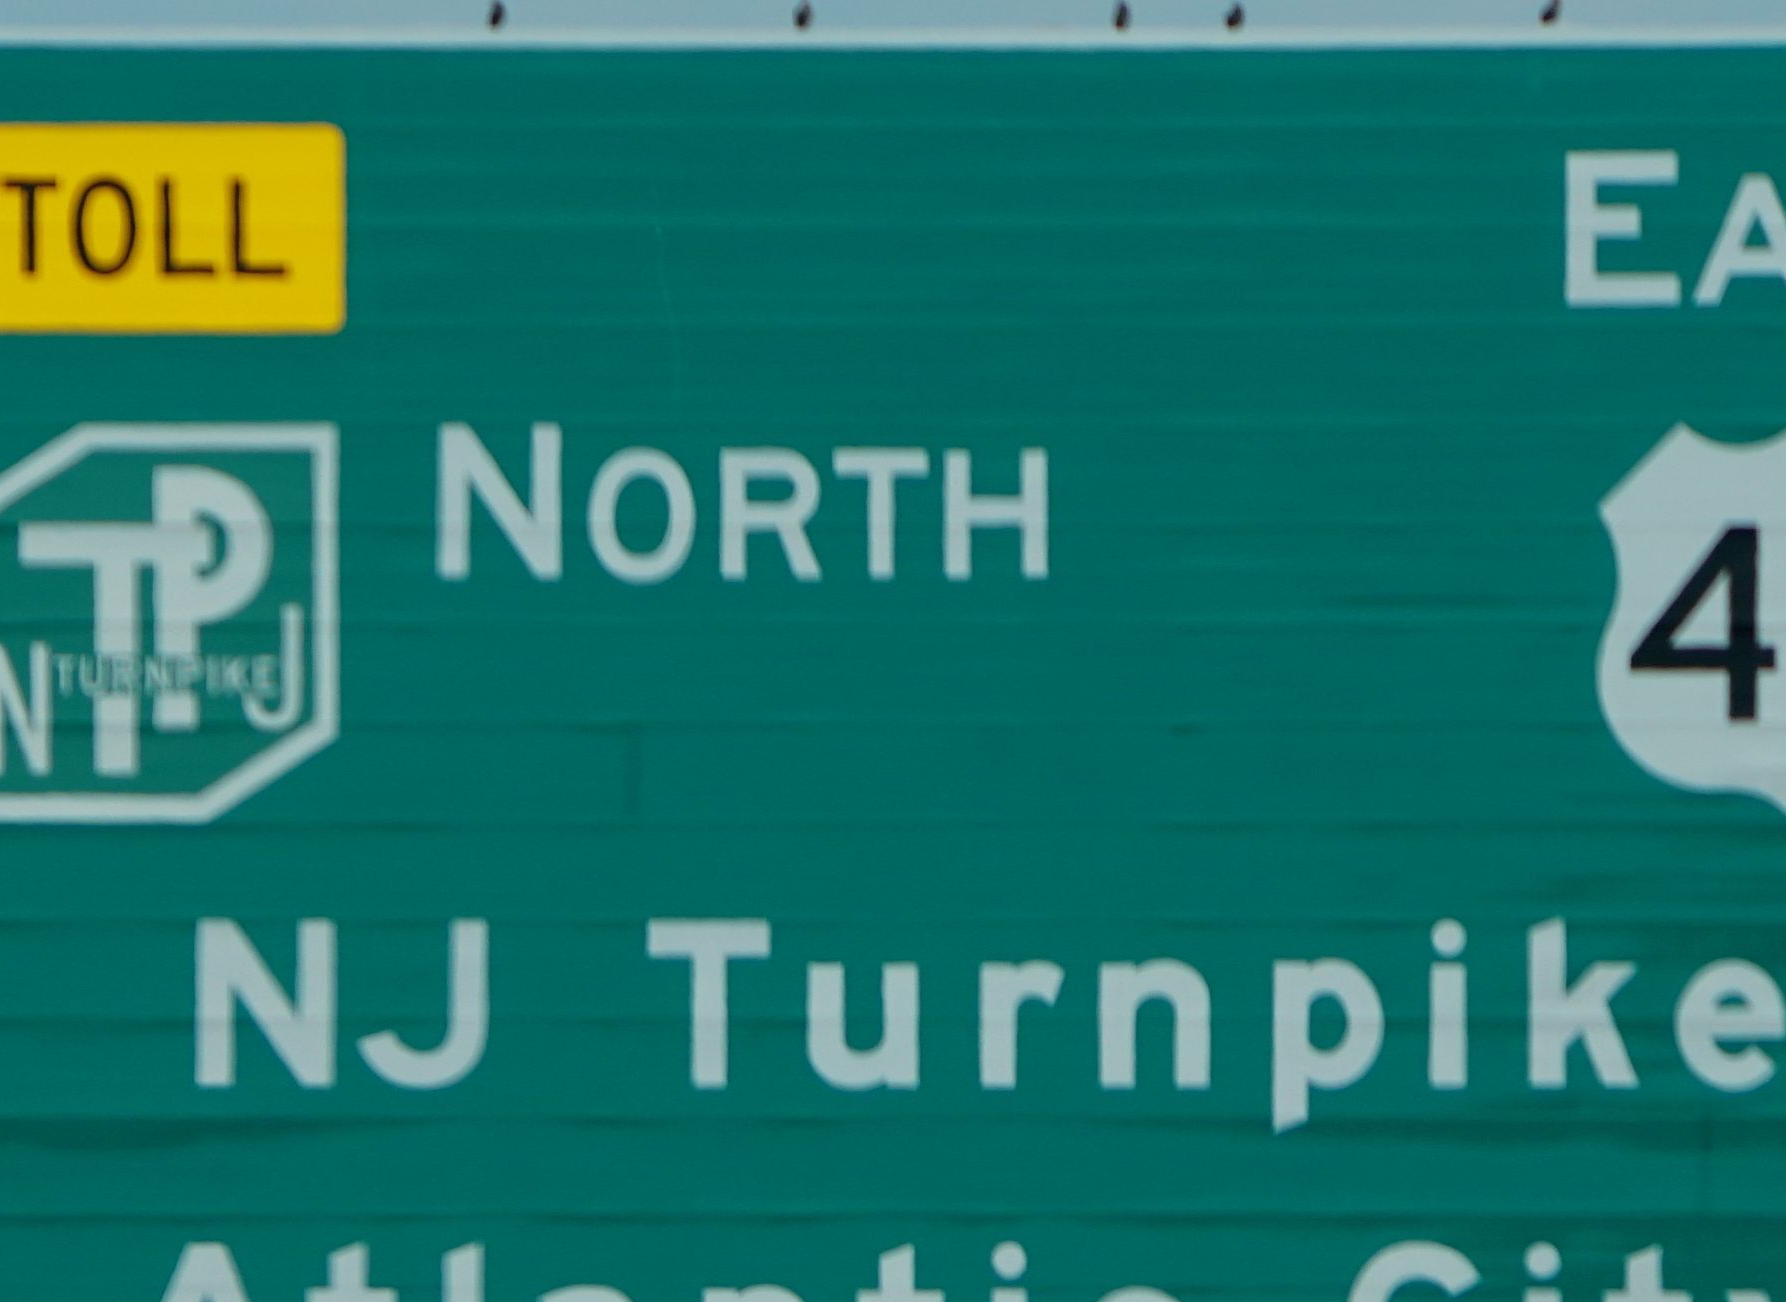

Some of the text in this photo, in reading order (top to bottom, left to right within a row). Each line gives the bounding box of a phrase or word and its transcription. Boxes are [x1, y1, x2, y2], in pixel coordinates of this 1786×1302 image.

[2, 175, 288, 279] TOLL
[435, 421, 1050, 584] NORTH
[53, 654, 280, 697] TURNPIKE
[194, 917, 491, 1090] NJ
